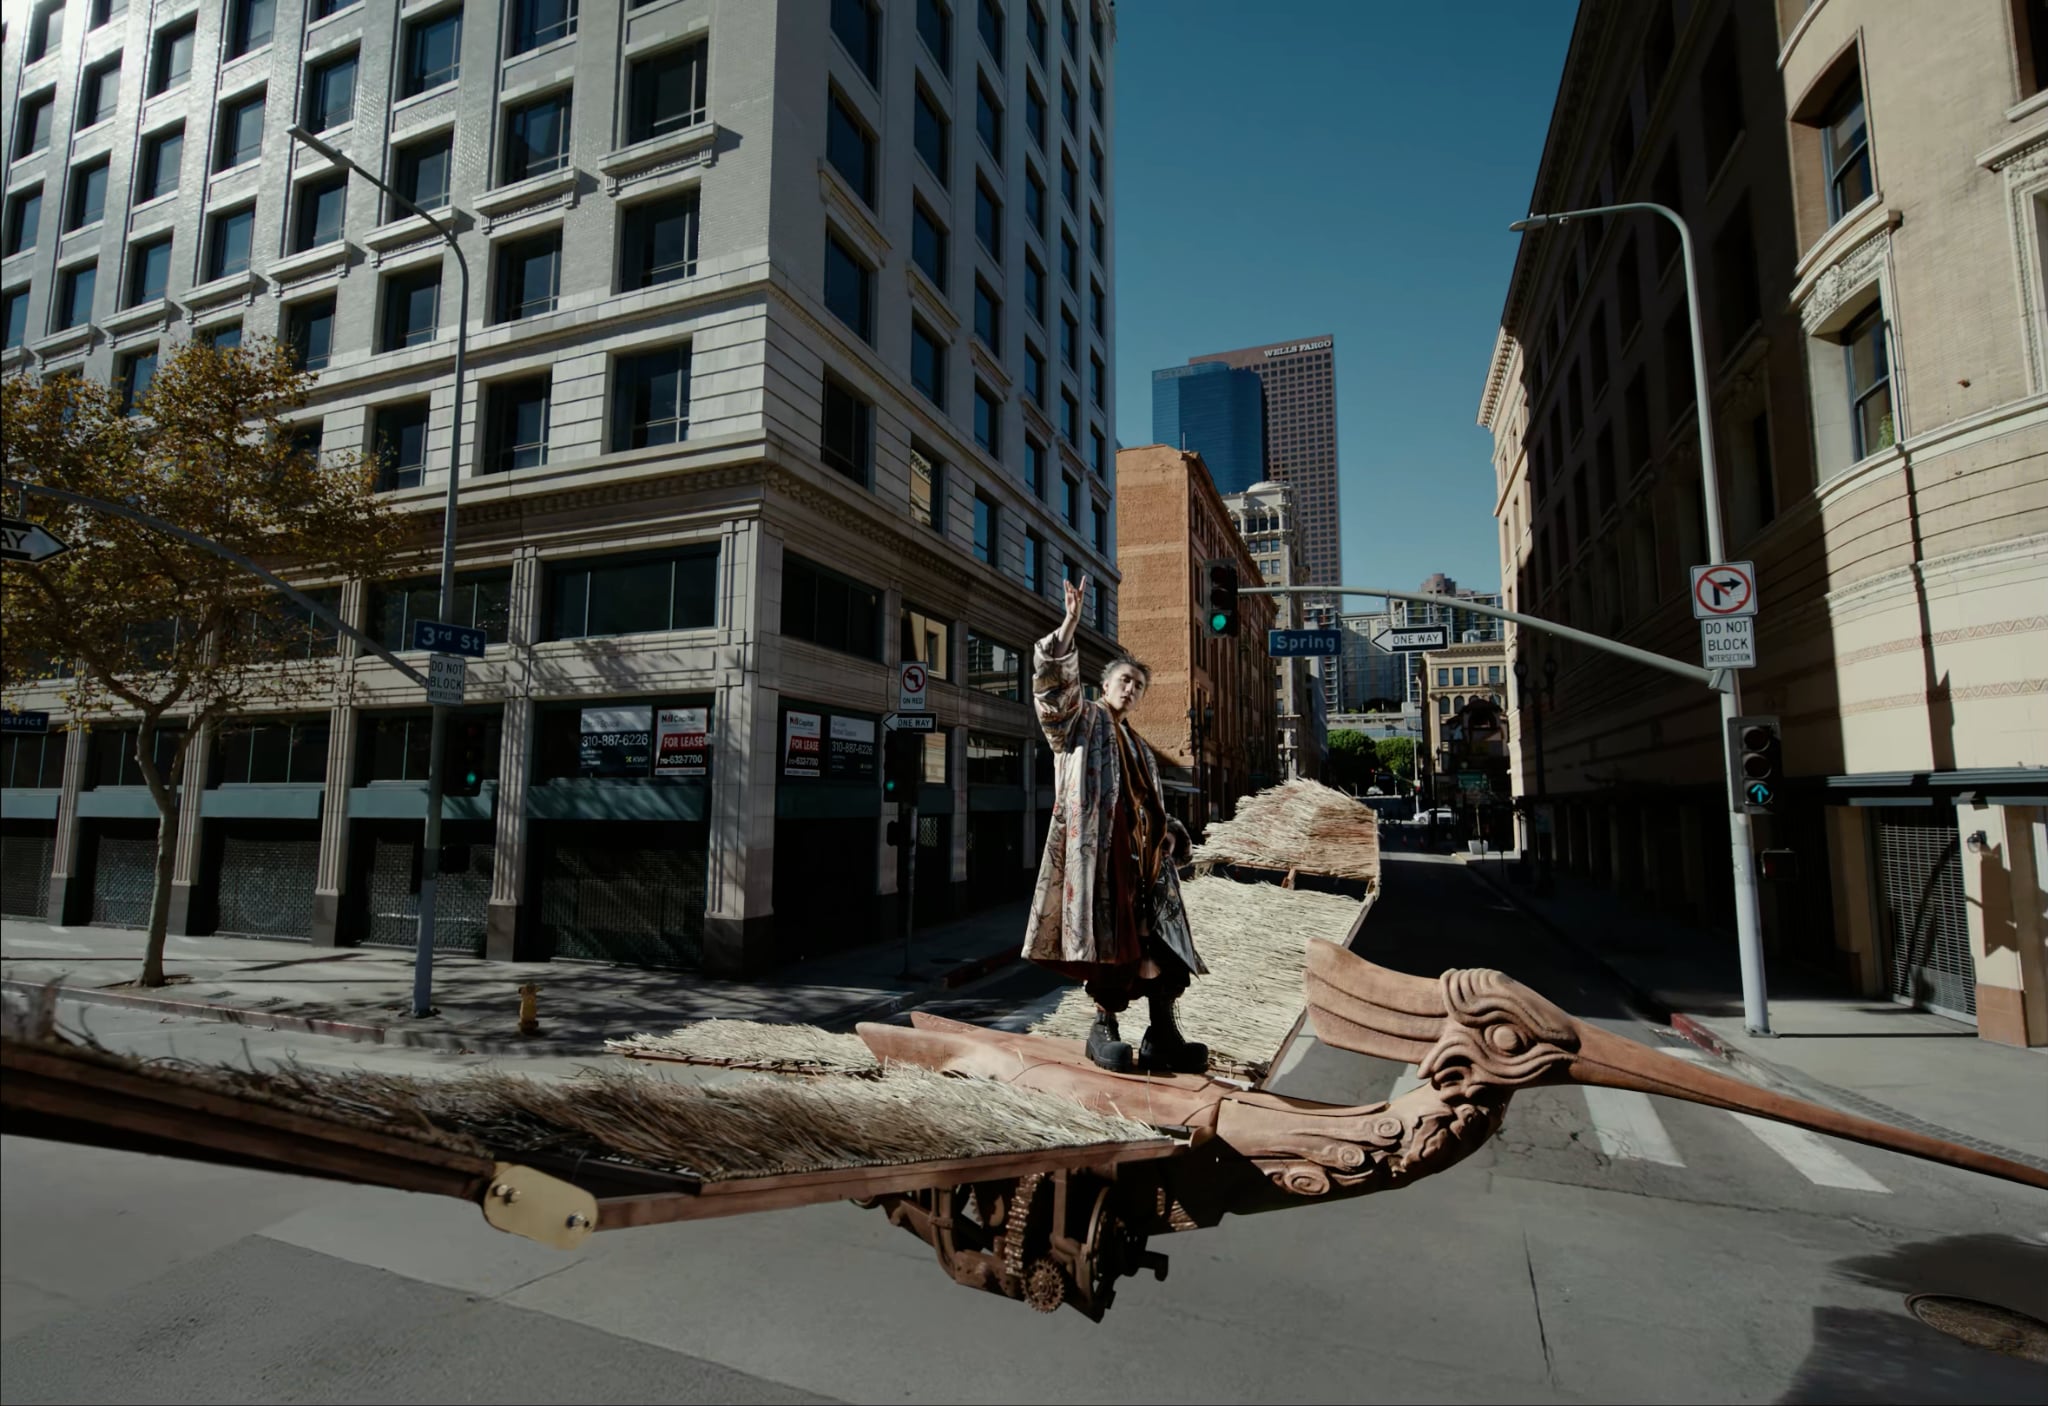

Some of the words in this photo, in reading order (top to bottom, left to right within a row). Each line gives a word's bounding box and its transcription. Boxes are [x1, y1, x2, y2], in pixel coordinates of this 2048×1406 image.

[1264, 346, 1297, 358] WELLS
[1300, 340, 1332, 352] FARGO
[1706, 623, 1721, 634] DO
[1726, 621, 1747, 633] NOT
[422, 627, 452, 646] 3rd
[460, 635, 480, 650] St
[1276, 635, 1336, 652] Spring
[1392, 634, 1414, 645] ONE
[1417, 633, 1440, 643] WAY
[1708, 639, 1748, 651] BLOCK
[1709, 654, 1750, 662] INTERSECTION
[431, 661, 444, 673] DO
[446, 663, 462, 675] NOT
[431, 677, 462, 690] BLOCK
[898, 719, 913, 727] ONE
[915, 719, 930, 727] WAY
[582, 734, 648, 747] 310-887-6226
[663, 737, 679, 749] FOR
[680, 736, 703, 748] LEASE
[791, 738, 803, 750] FOR
[804, 739, 819, 752] LEASE
